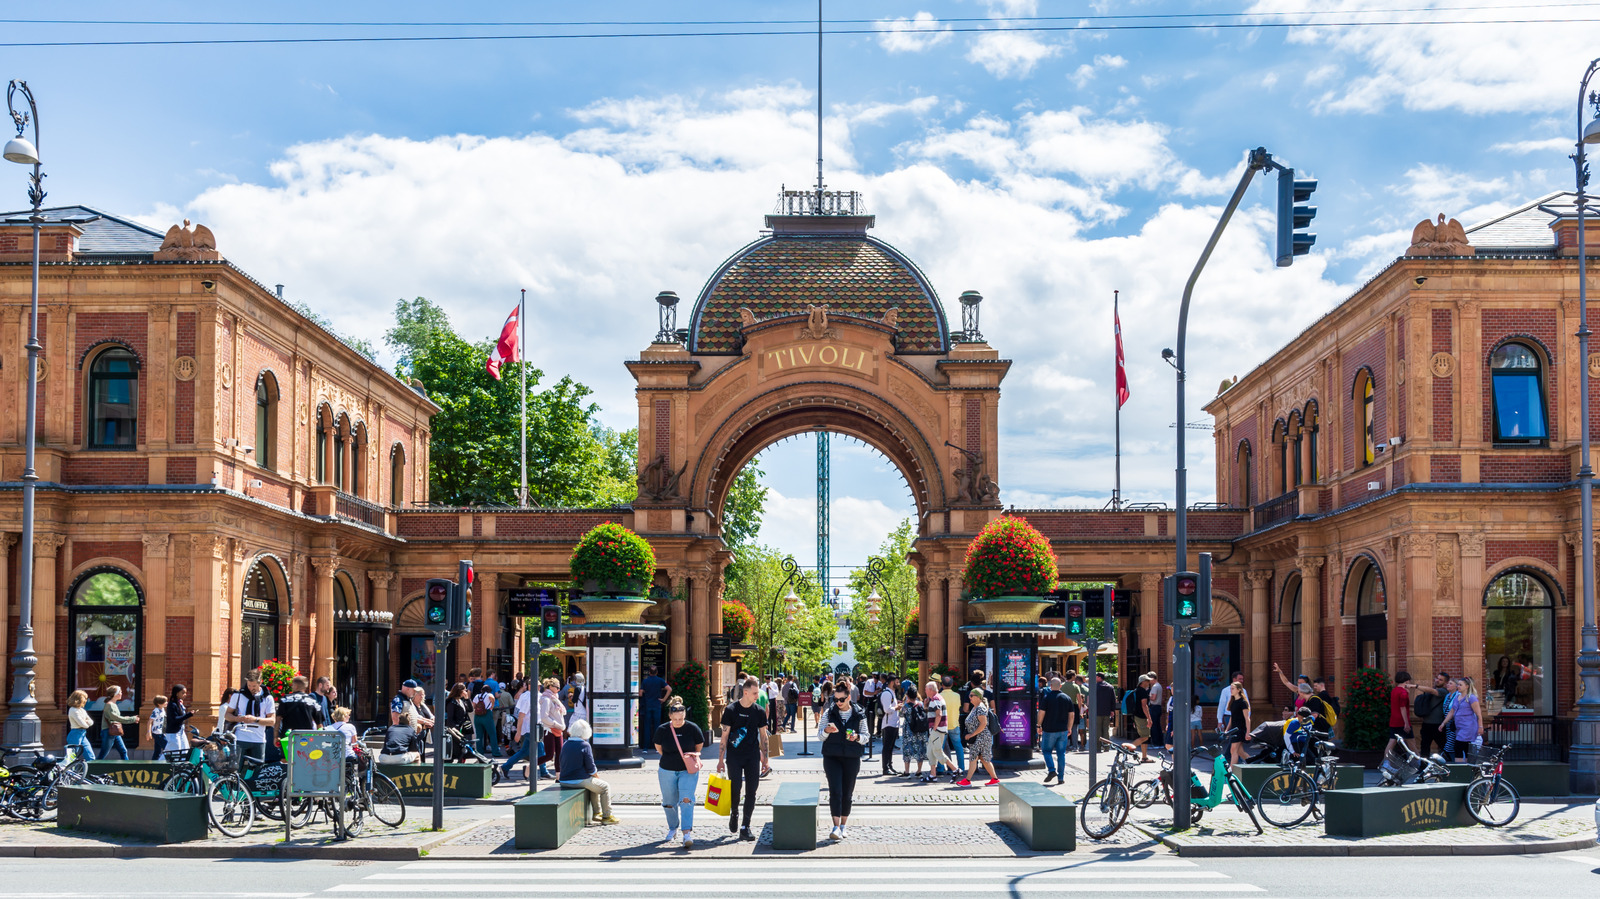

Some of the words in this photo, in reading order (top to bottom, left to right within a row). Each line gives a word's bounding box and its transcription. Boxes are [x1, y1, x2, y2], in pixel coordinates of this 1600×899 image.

[785, 191, 854, 215] TIVOLI
[768, 346, 865, 370] TIVOLI
[254, 601, 268, 610] OFFICE
[708, 791, 720, 801] LEGO
[1401, 797, 1449, 824] TIVOLI
